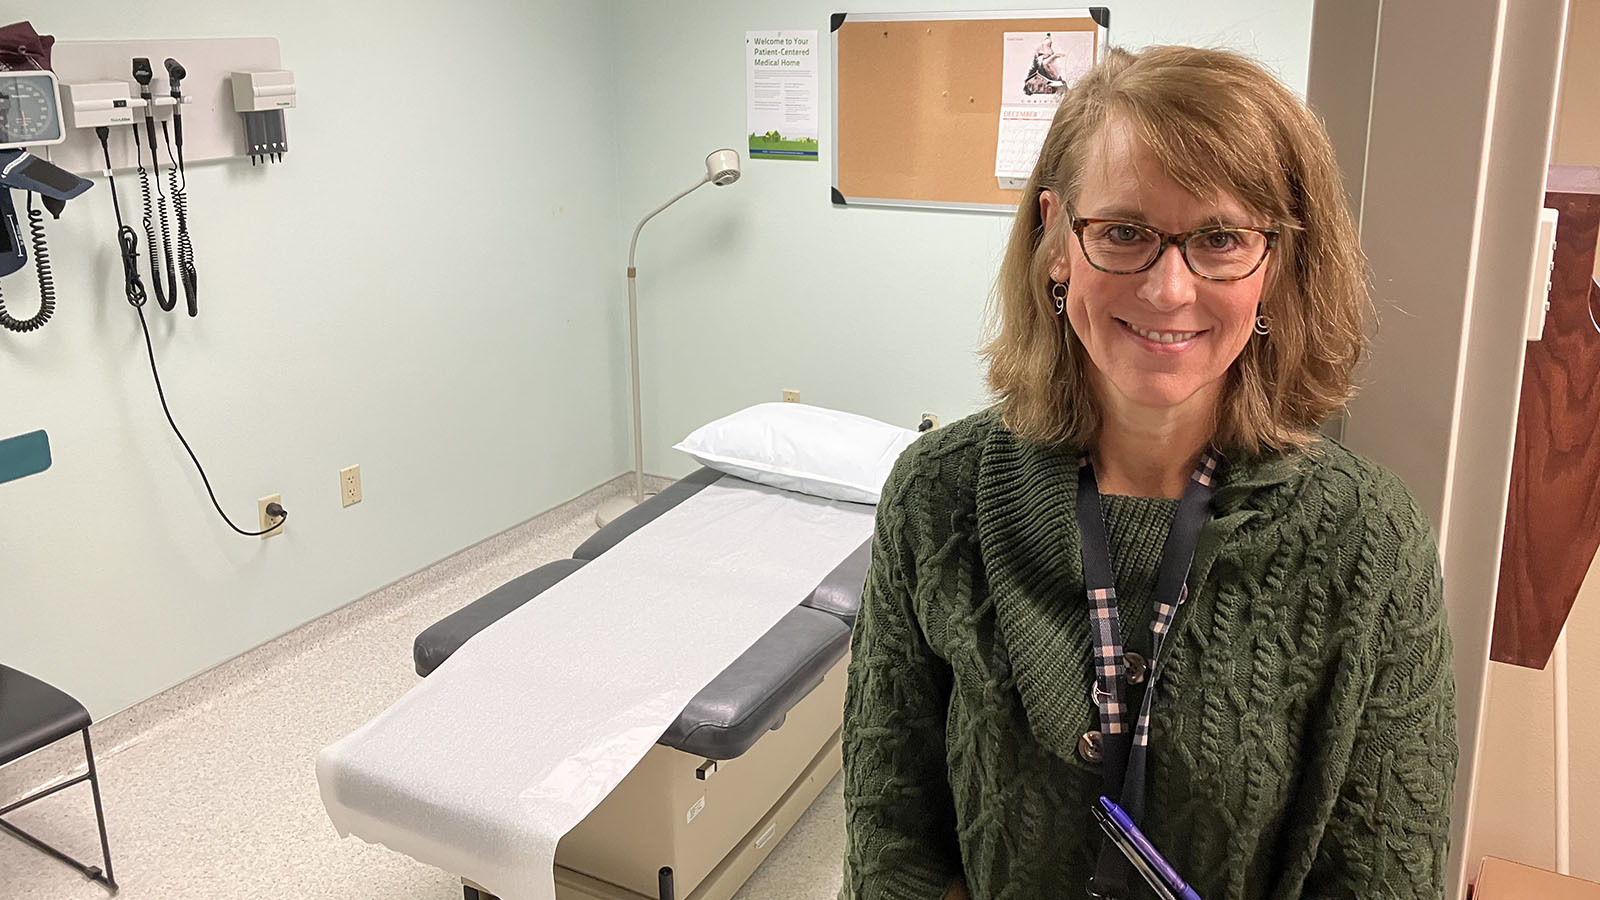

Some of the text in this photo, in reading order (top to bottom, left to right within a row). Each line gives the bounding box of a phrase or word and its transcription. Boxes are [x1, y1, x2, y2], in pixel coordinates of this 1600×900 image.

[754, 37, 784, 45] Welcome
[794, 37, 809, 45] Your
[754, 48, 810, 56] Patient-Centered
